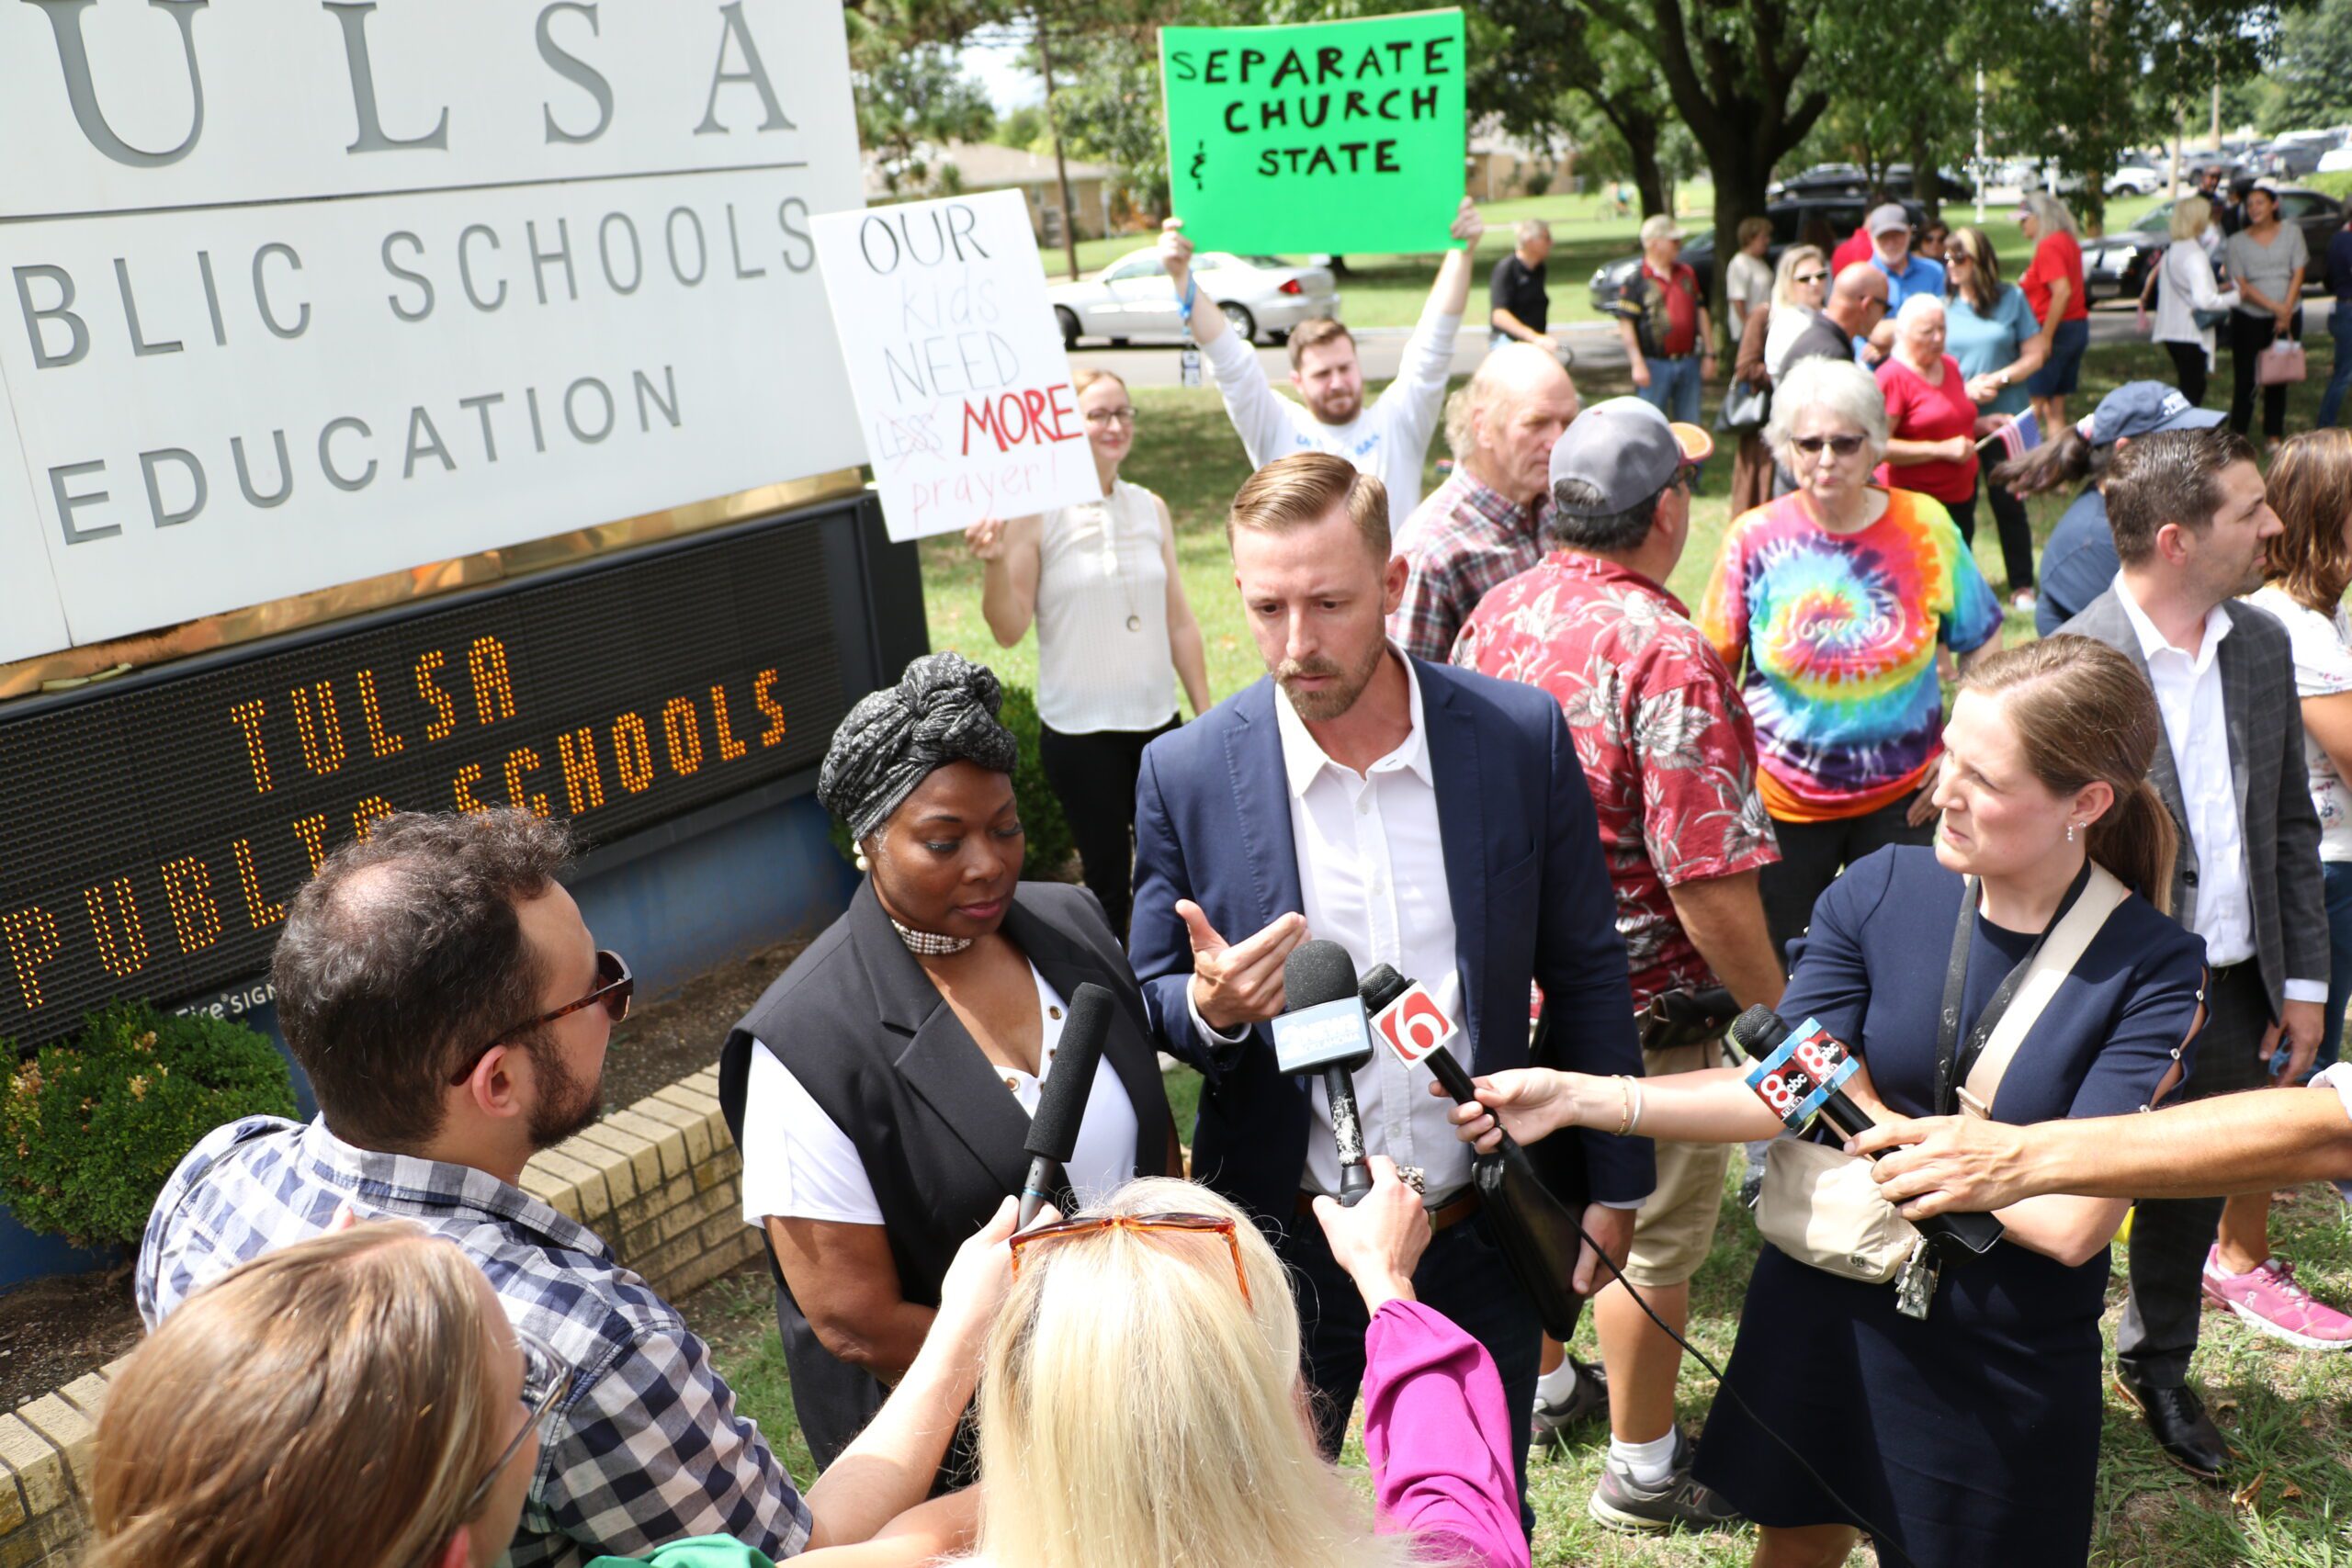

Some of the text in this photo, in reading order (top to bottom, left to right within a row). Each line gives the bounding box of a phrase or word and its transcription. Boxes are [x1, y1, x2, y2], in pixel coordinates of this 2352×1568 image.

[20, 0, 797, 168] ULSA
[1171, 36, 1454, 89] SEPARATE
[1224, 85, 1439, 133] CHURCH
[1258, 140, 1400, 176] STATE
[860, 204, 990, 275] OUR
[12, 196, 816, 369] BLIC SCHOOLS
[885, 331, 1020, 404] NEED
[48, 365, 684, 546] EDUCATION
[961, 383, 1083, 457] MORE
[912, 450, 1057, 534] prayer!
[231, 636, 516, 794] TULSA
[454, 668, 787, 818] SCHOOLS
[1395, 990, 1445, 1056] 6
[1797, 1041, 1831, 1075] 8
[1760, 1073, 1808, 1109] 8 abc
[1781, 1096, 1804, 1117] TULSA
